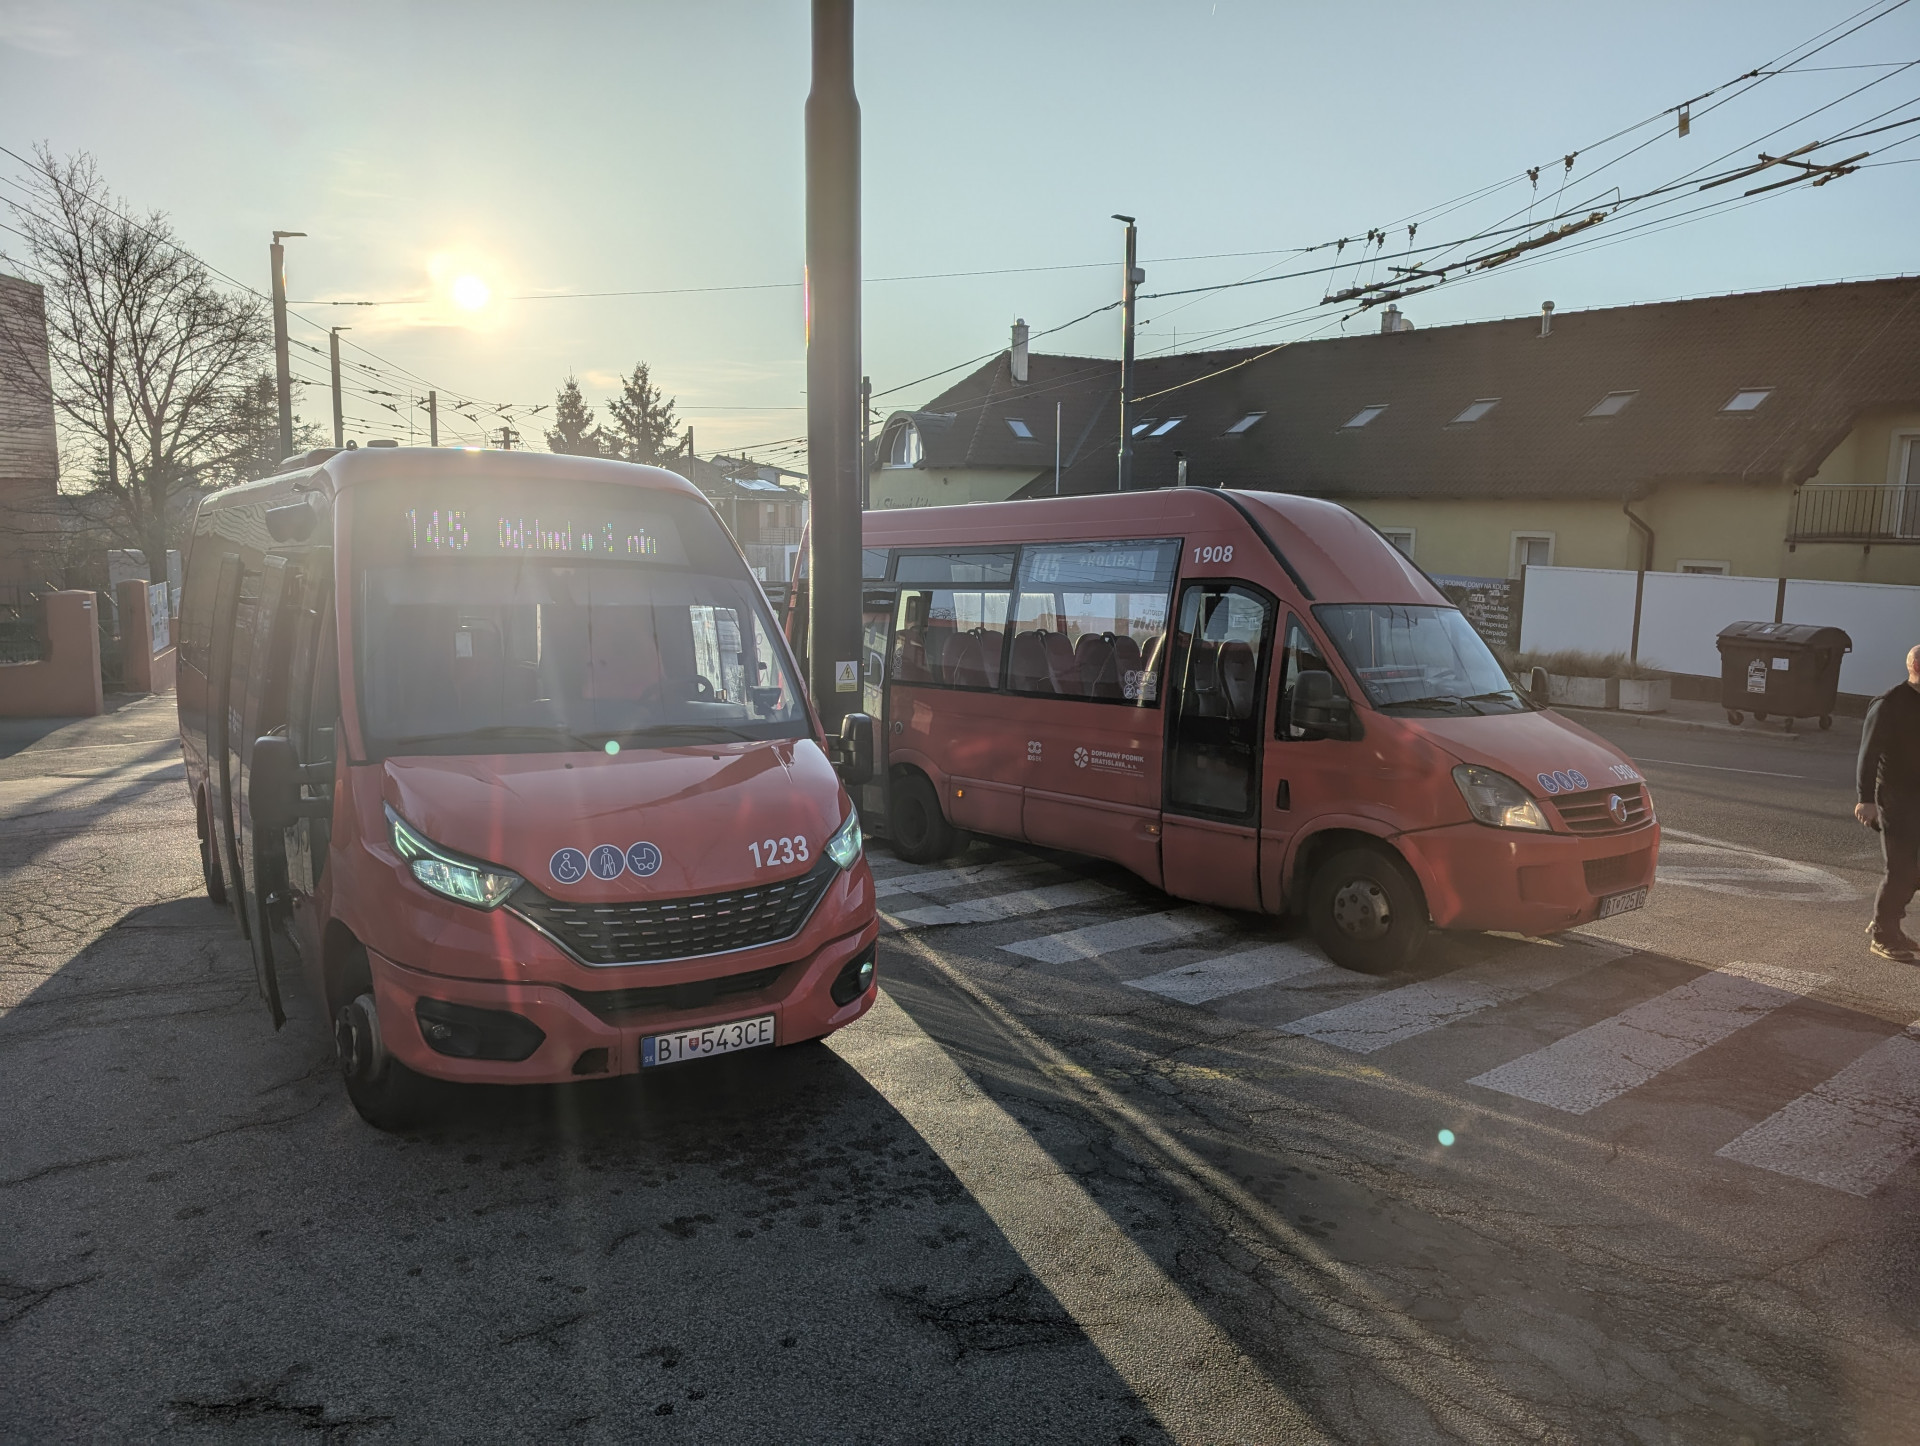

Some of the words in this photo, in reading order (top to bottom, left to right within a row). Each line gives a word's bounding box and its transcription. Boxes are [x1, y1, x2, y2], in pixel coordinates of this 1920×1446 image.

[404, 508, 468, 550] 145
[1031, 553, 1061, 582] 145
[1193, 546, 1233, 564] 1908
[1091, 749, 1121, 760] DOPRAVNÝ
[1121, 753, 1144, 763] PODNIK
[1608, 764, 1639, 781] 1908
[747, 835, 811, 868] 1233
[644, 1055, 654, 1063] SK
[658, 1035, 688, 1062] BT
[701, 1019, 771, 1053] 543CE
